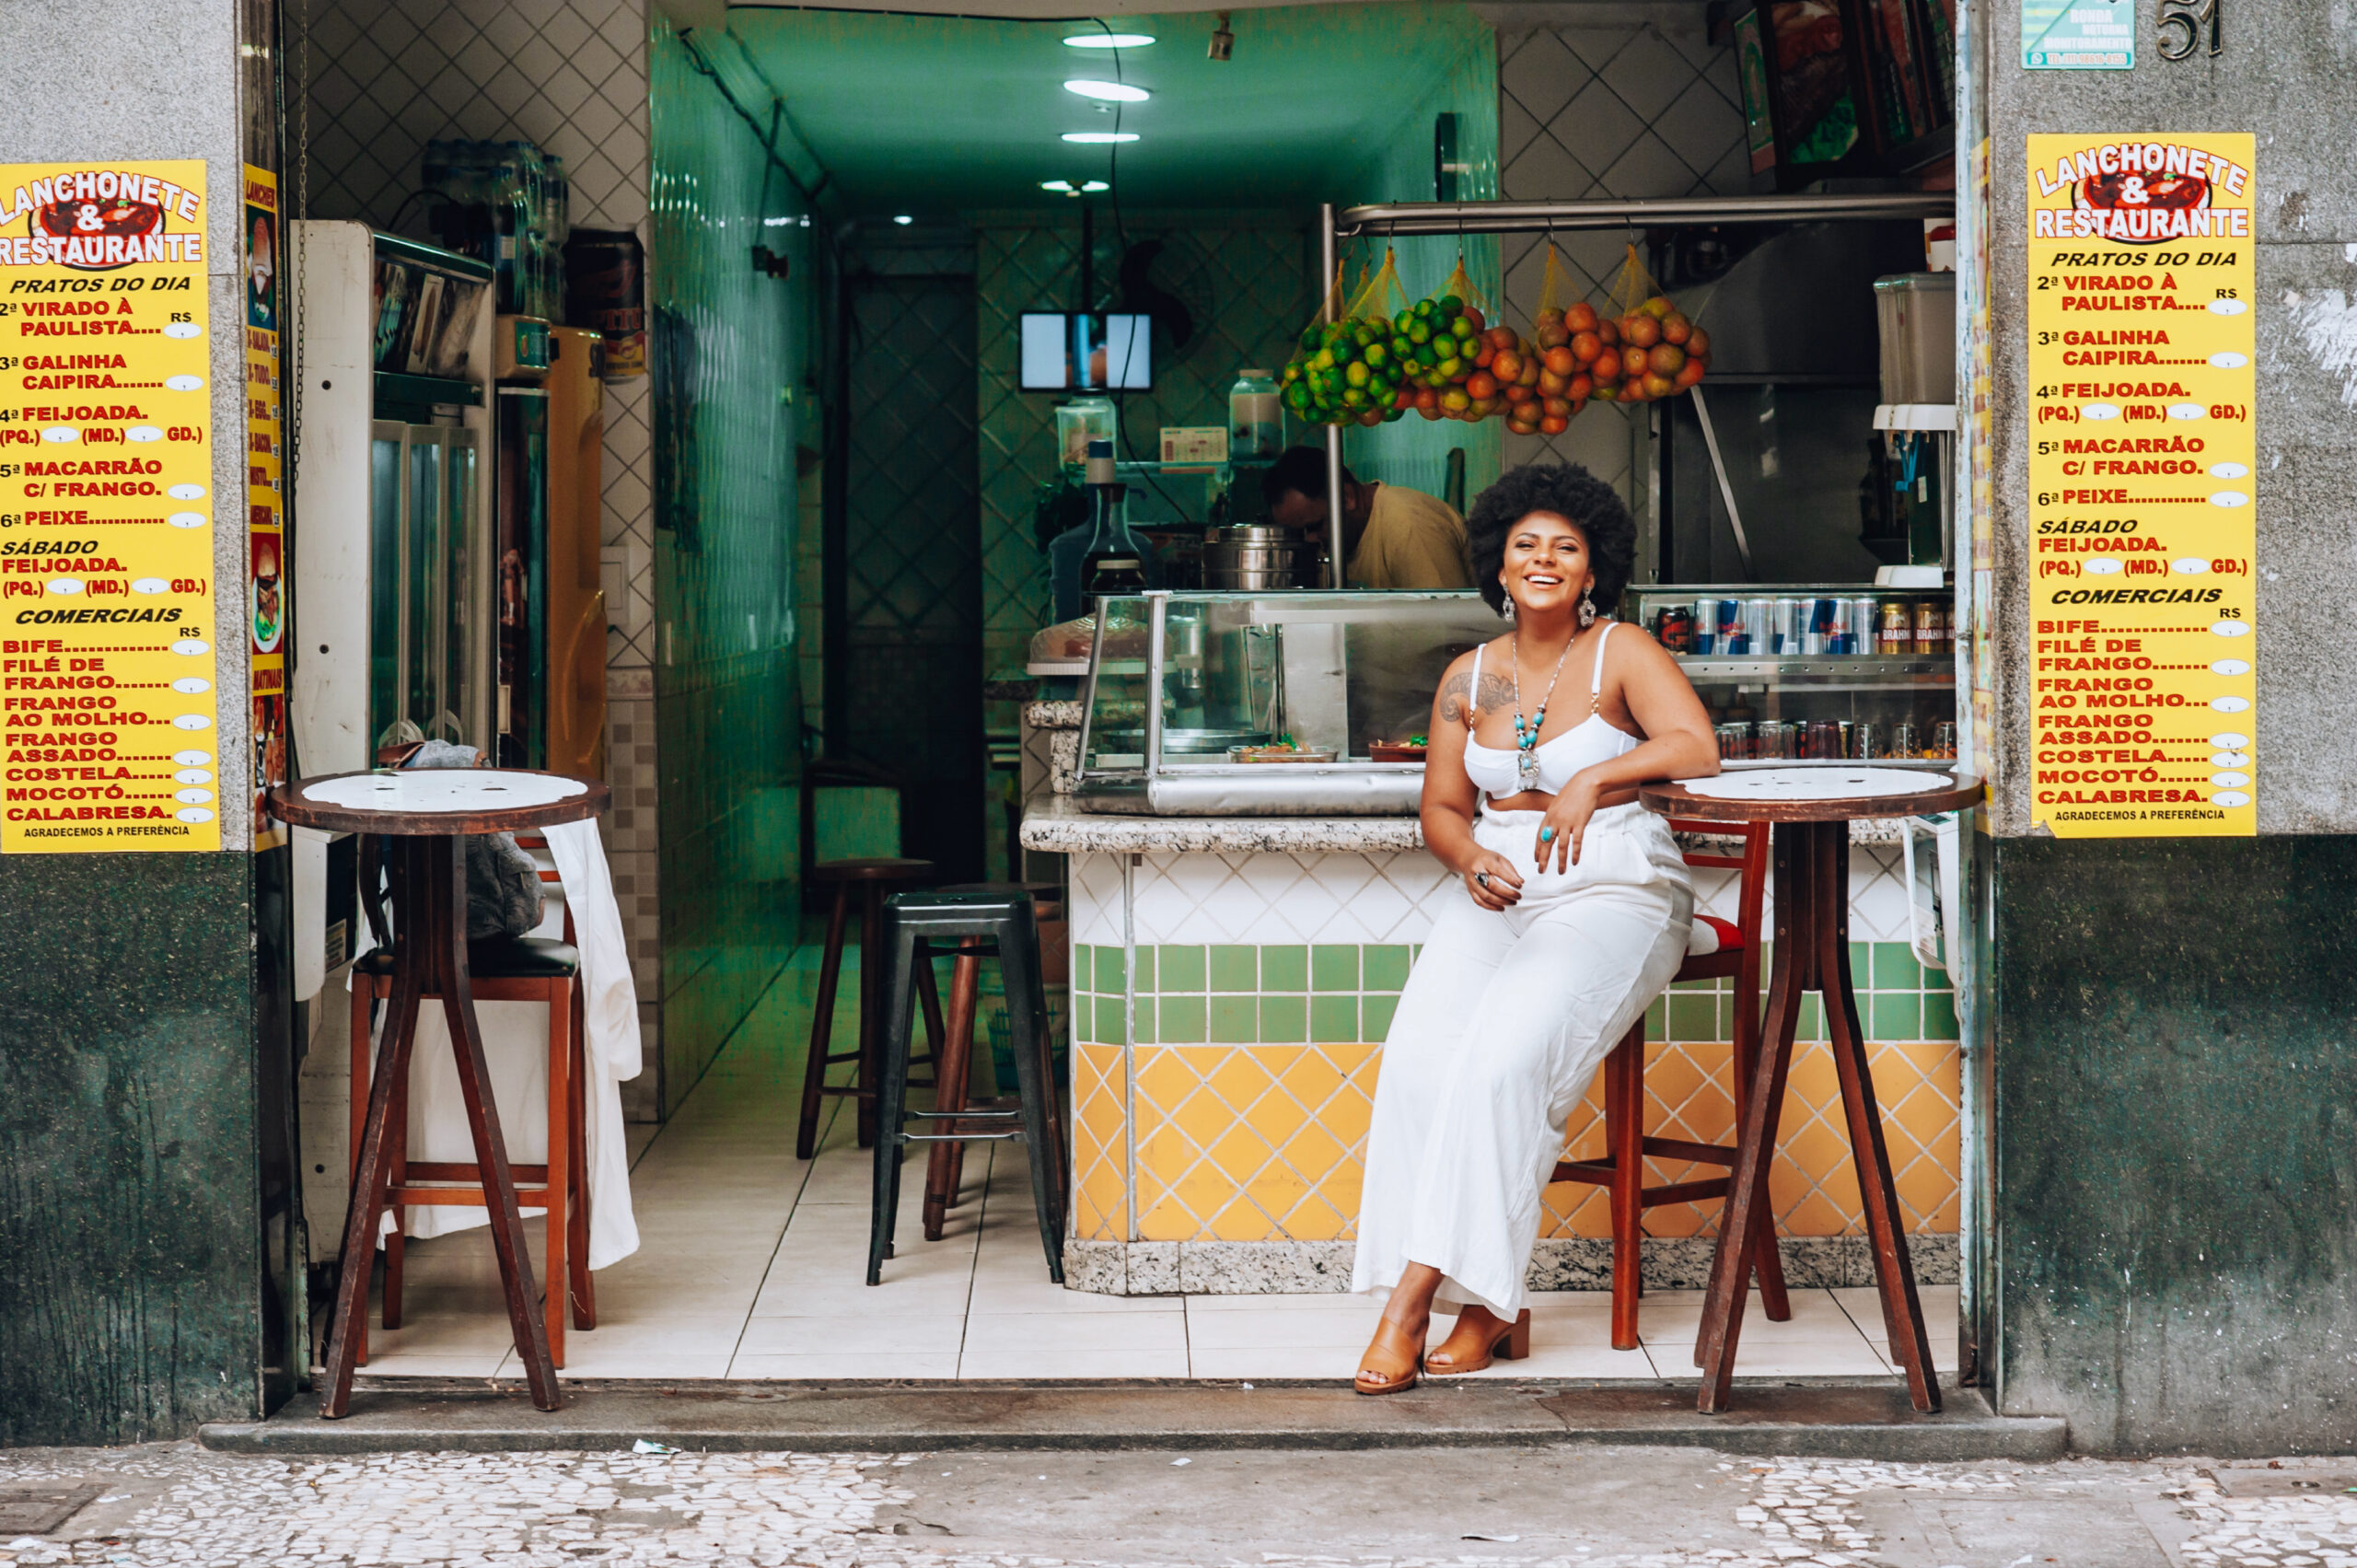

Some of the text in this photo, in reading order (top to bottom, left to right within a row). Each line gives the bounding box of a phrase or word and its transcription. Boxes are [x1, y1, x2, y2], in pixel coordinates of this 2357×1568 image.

[2070, 9, 2113, 23] RONDA
[2043, 37, 2132, 49] MONITORAMENTO
[2035, 142, 2249, 197] LANCHONETE
[0, 170, 201, 226] LANCHONETE
[2120, 176, 2151, 204] &
[76, 203, 106, 232] &
[2035, 208, 2249, 238] RESTAURANTE
[0, 233, 202, 265] RESTAURANTE
[2051, 252, 2236, 267] PRATOS DO DIA
[9, 276, 191, 294] PRATOS DO DIA
[2062, 275, 2154, 291] VIRADO
[2160, 272, 2177, 290] À
[2216, 288, 2237, 299] R$
[21, 300, 110, 317] VIRADO
[116, 296, 134, 315] À
[170, 312, 192, 323] R$
[2062, 330, 2170, 346] GALINHA
[22, 354, 127, 370] GALINHA
[2062, 382, 2191, 398] FEIJOADA.
[22, 405, 148, 422] FEIJOADA.
[2038, 404, 2247, 424] (PQ.) (MD.) GD.)
[0, 426, 203, 448] (PQ.) (MD.) GD.)
[2063, 435, 2205, 454] MACARRÃO
[24, 457, 163, 477] MACARRÃO
[2062, 459, 2203, 476] C/ FRANGO.
[23, 481, 162, 498] C/ FRANGO.
[2037, 516, 2138, 534] SÁBADO
[0, 537, 99, 556] SÁBADO
[2038, 537, 2167, 553] FEIJOADA.
[2, 557, 128, 574] FEIJOADA.
[2038, 558, 2247, 579] (PQ.) (MD.) GD.)
[3, 578, 206, 599] (PQ.) (MD.) GD.)
[2051, 588, 2223, 605] COMERCIAIS
[16, 608, 182, 625] COMERCIAIS
[2220, 608, 2241, 619] R$
[180, 627, 201, 637] R$
[2038, 636, 2142, 654] FILÉ DE
[3, 656, 105, 673] FILÉ DE
[2038, 677, 2154, 692] FRANGO
[4, 695, 117, 711] FRANGO
[2038, 694, 2077, 709] AO
[6, 713, 43, 727] AO
[2038, 714, 2154, 728] FRANGO
[6, 731, 118, 747] FRANGO
[2038, 789, 2208, 805] CALABRESA.
[6, 806, 173, 821] CALABRESA.
[2055, 808, 2224, 821] AGRADECEMOS A PREFERÊNCIA
[24, 825, 190, 837] AGRADECEMOS A PREFERÊNCIA
